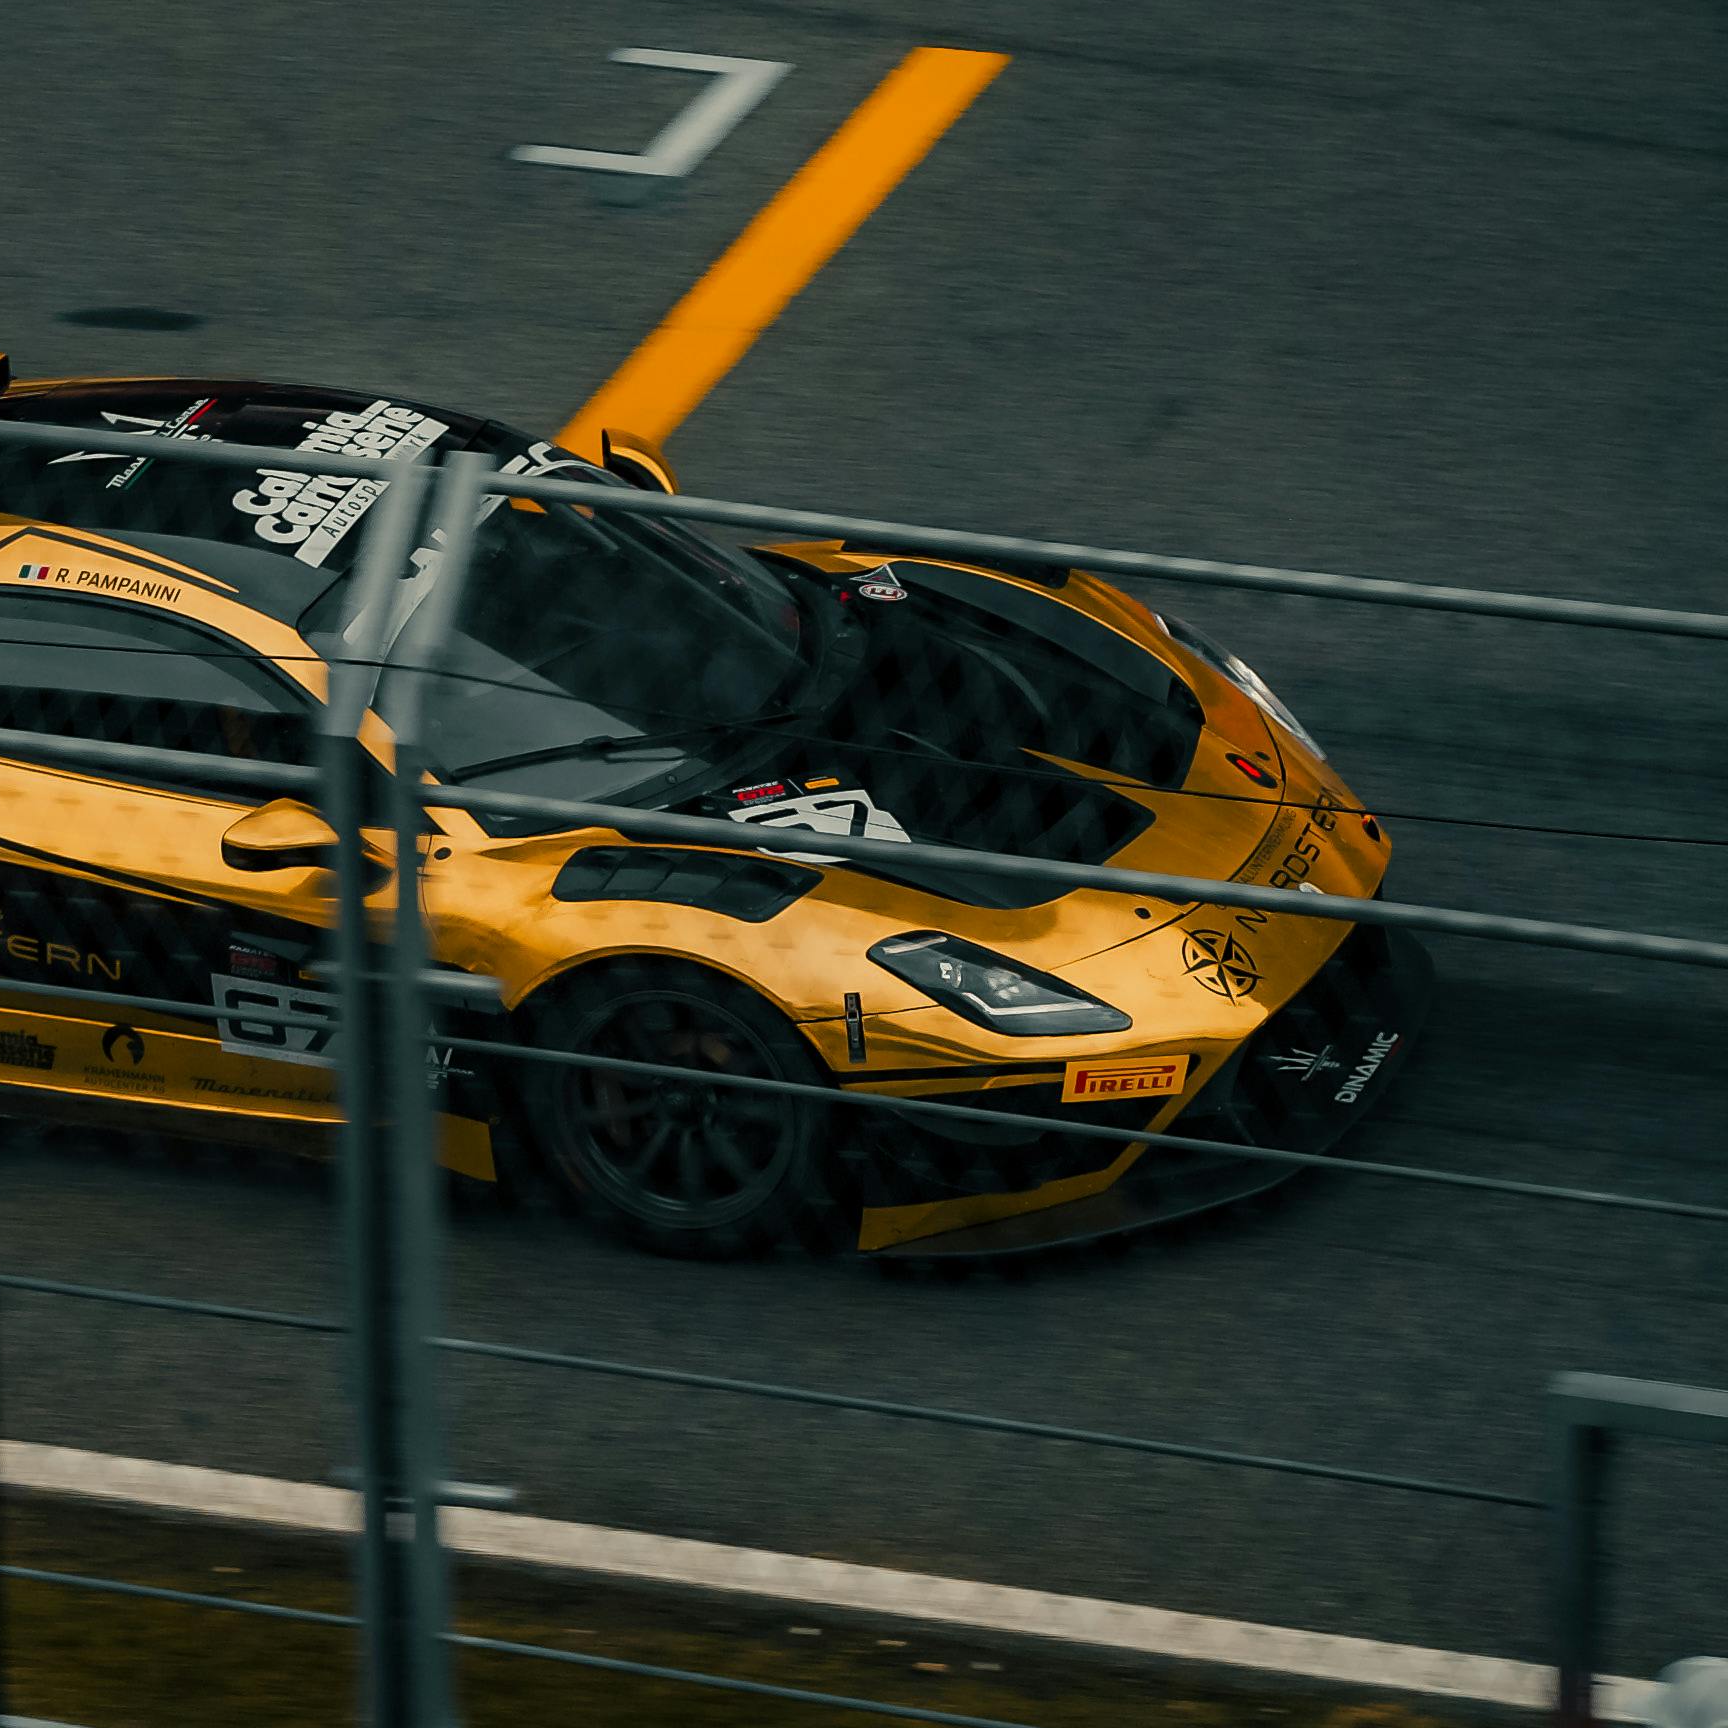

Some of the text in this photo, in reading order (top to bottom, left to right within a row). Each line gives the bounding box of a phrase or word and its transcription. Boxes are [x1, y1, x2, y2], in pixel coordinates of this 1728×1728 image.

[232, 410, 366, 516] Calmia
[254, 405, 426, 544] Carrserie
[55, 568, 71, 584] R.
[76, 571, 182, 604] PAMPANINI
[1233, 785, 1345, 935] NRDSTERN
[1074, 1065, 1177, 1095] PIRELLI
[1333, 1031, 1400, 1105] DINAMIC
